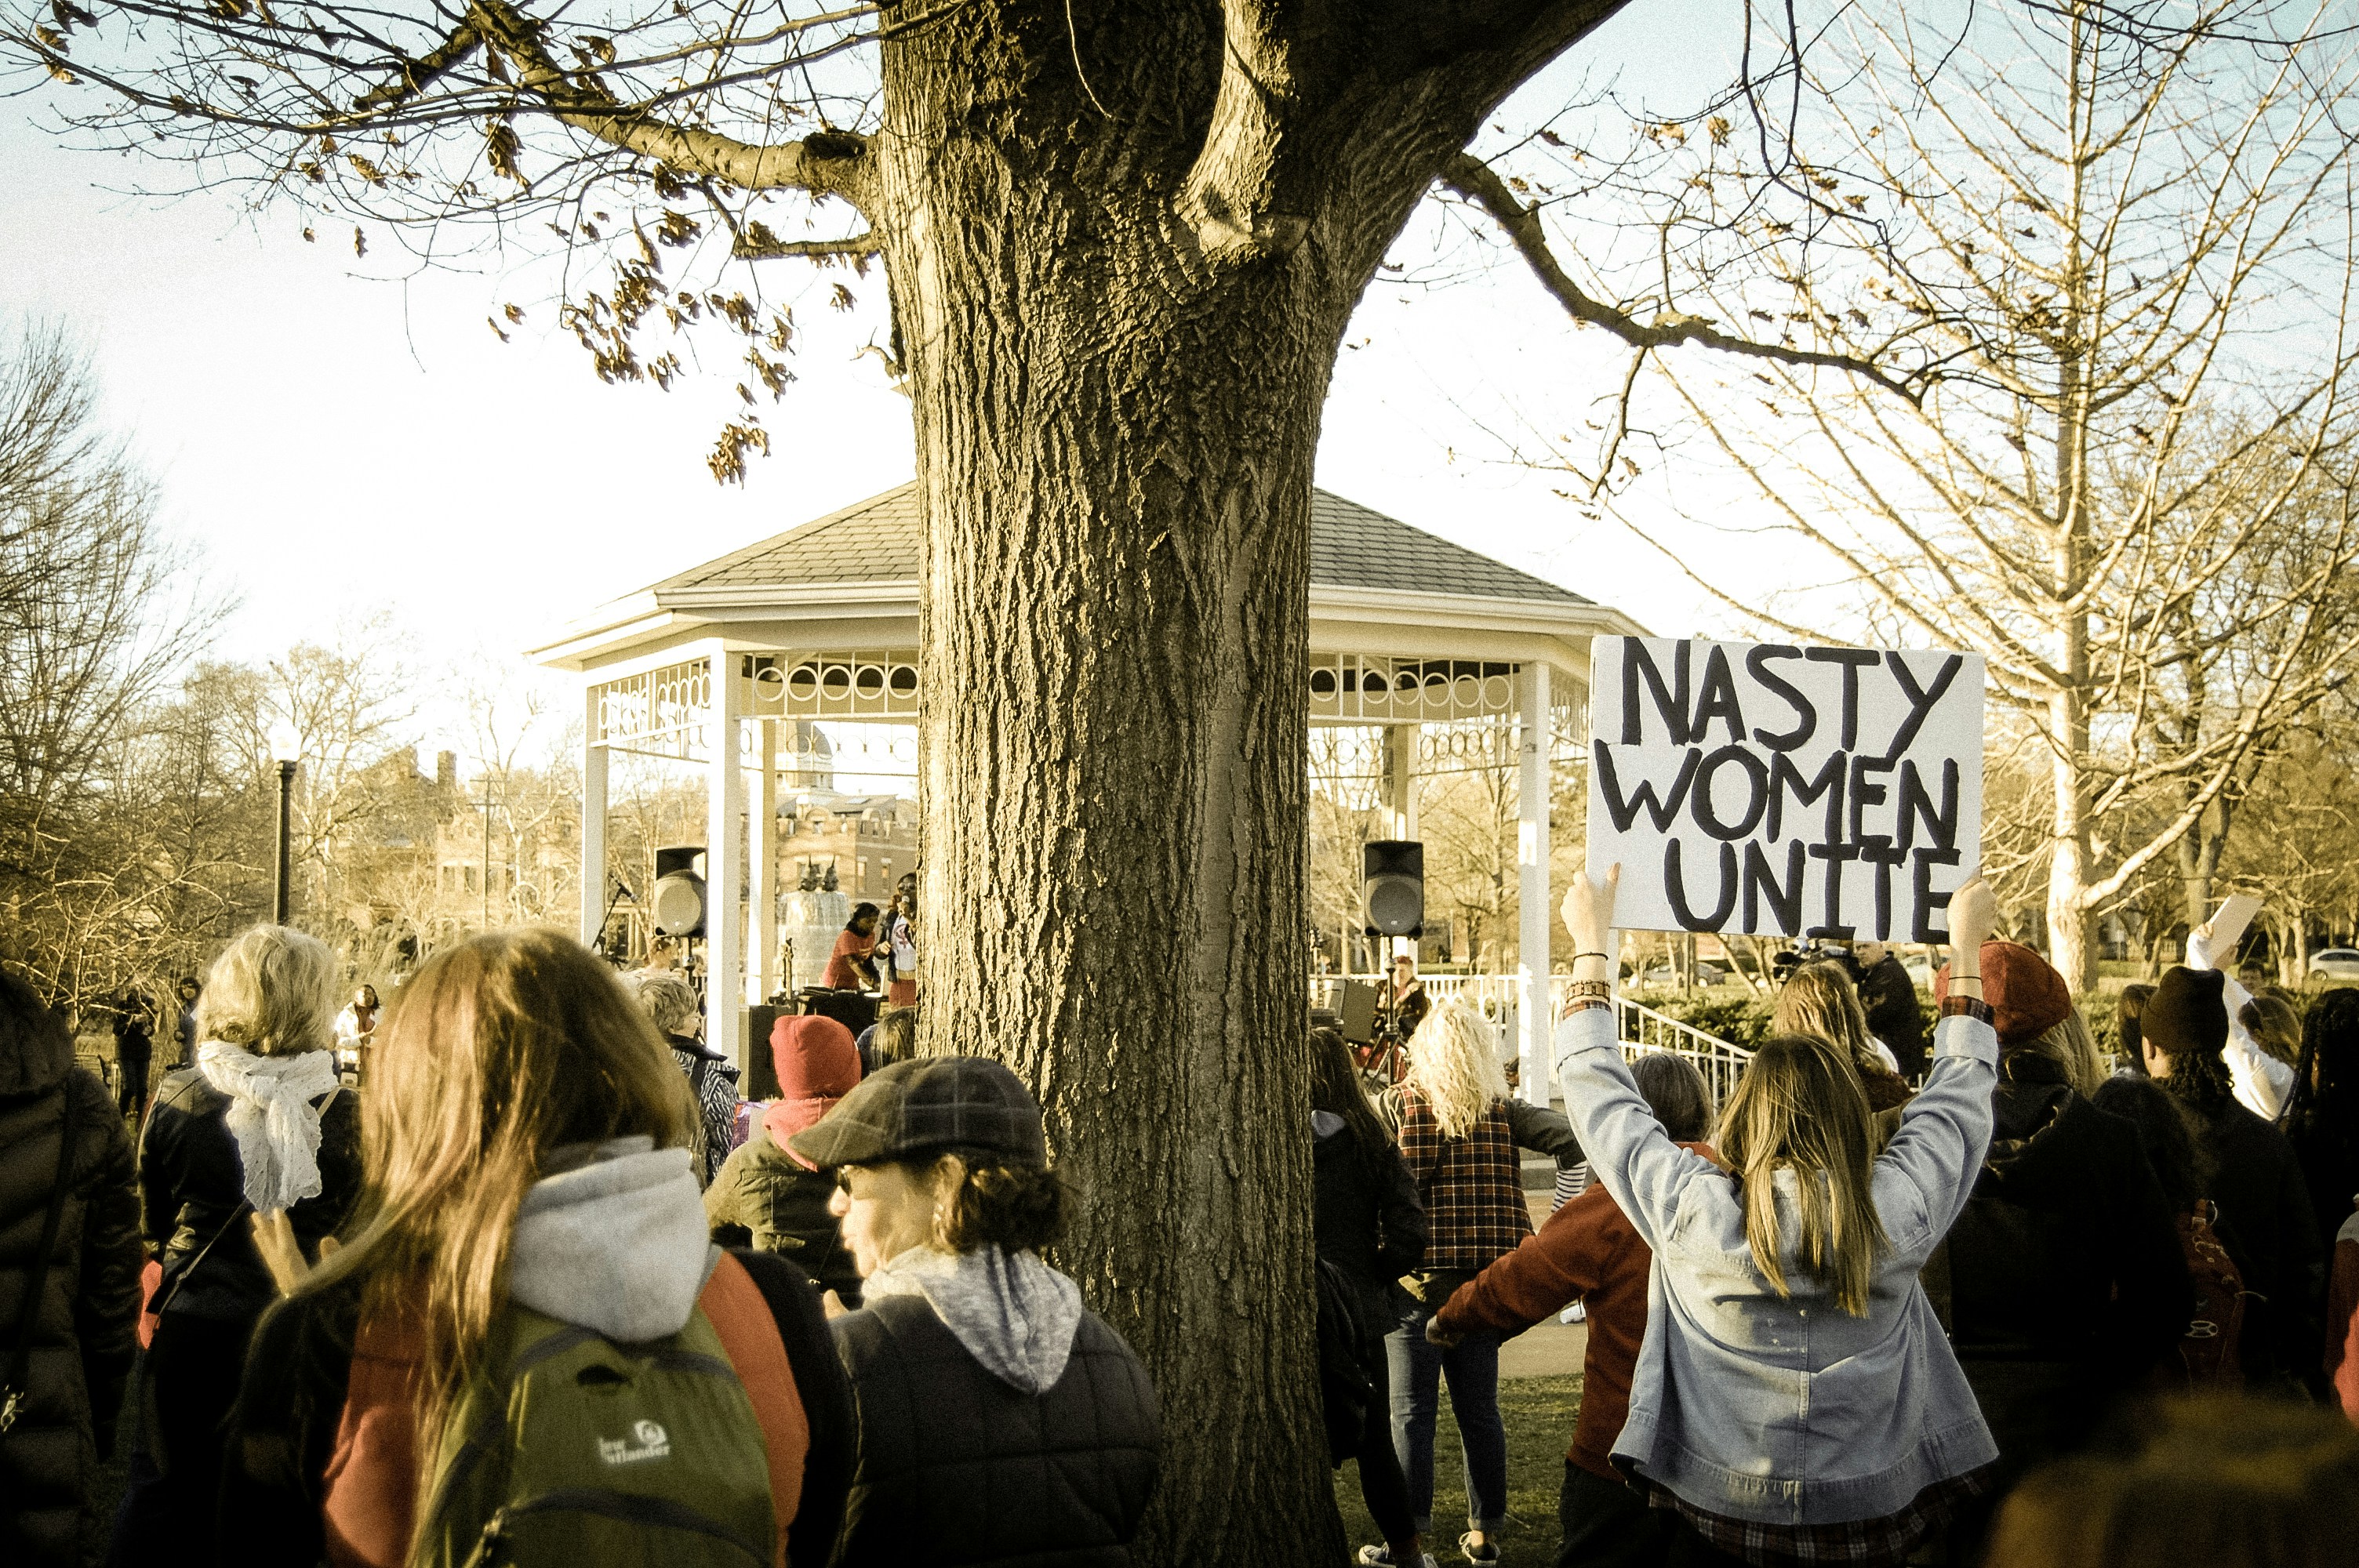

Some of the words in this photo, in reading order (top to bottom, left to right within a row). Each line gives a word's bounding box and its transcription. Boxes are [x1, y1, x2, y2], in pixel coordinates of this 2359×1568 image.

[1622, 636, 1963, 757] NASTY
[1594, 739, 1959, 850] WOMEN
[1664, 837, 1961, 945] UNITE
